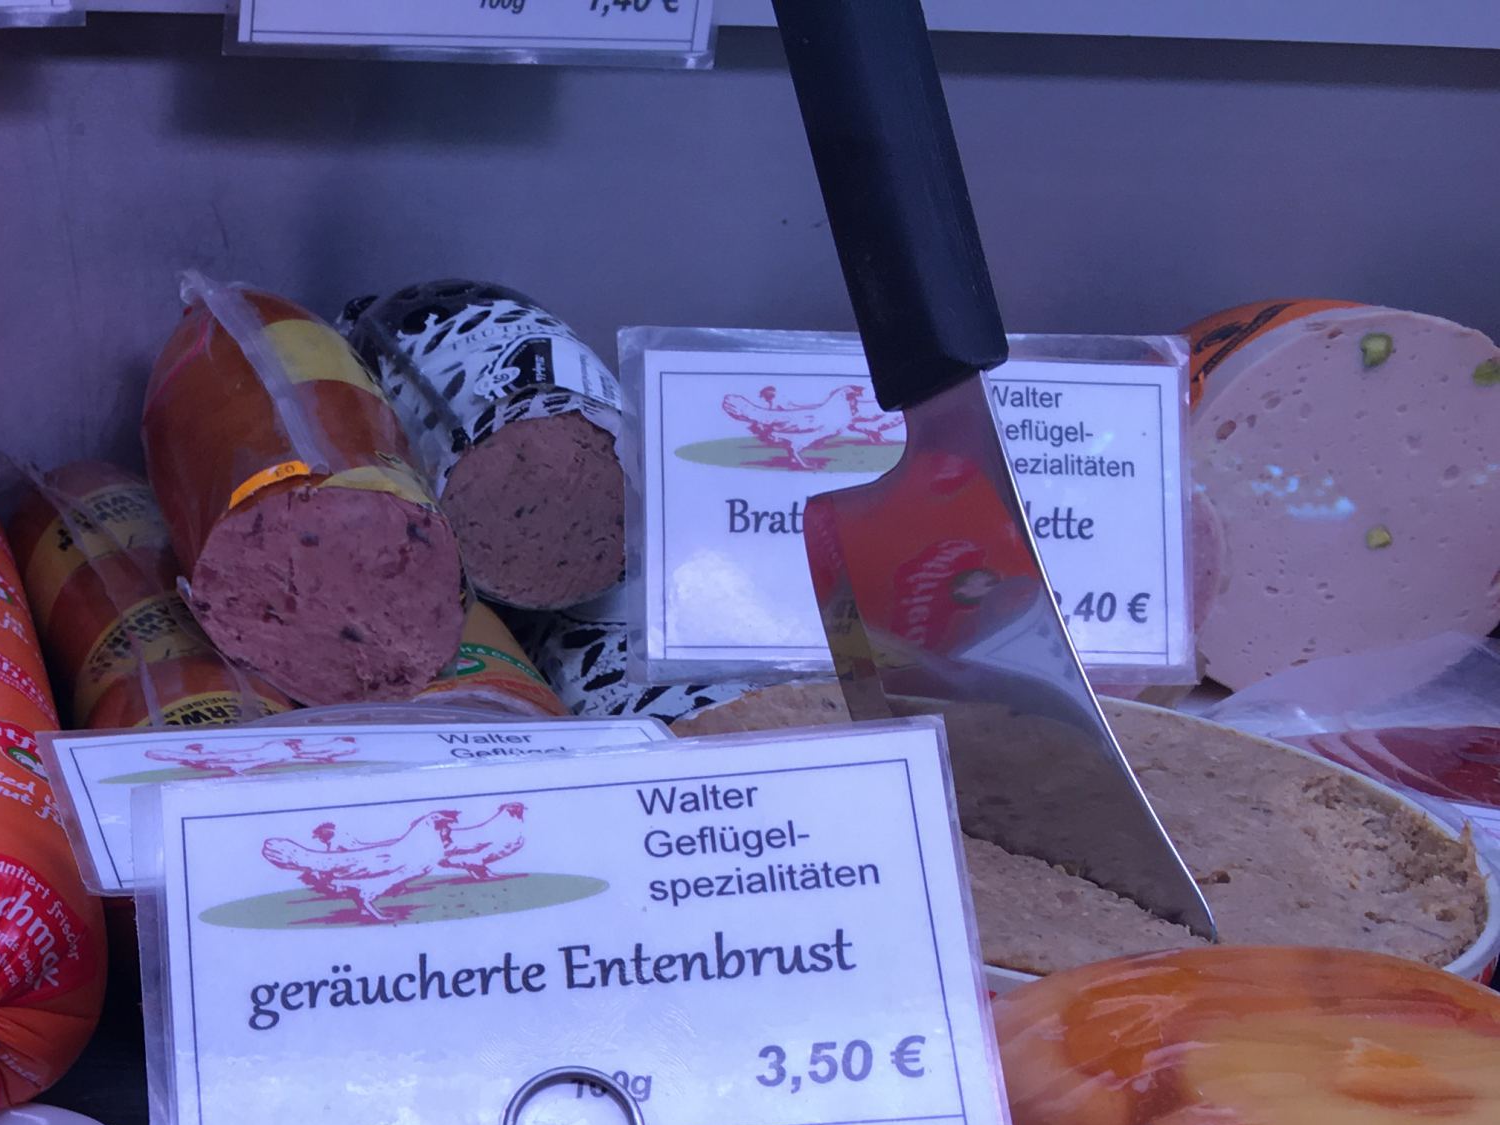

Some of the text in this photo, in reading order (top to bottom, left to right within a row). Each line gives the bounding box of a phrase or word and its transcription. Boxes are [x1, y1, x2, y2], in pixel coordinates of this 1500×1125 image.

[1000, 418, 1094, 448] eflügel-
[1012, 453, 1136, 478] ezialitäten
[724, 498, 804, 535] Brat
[1126, 592, 1152, 624] €
[437, 732, 533, 745] Walter
[637, 784, 758, 816] Walter
[643, 819, 810, 858] Geflügel-
[649, 861, 880, 907] spezialitäten
[248, 928, 858, 1031] geräucherte Entenbrust
[755, 1038, 874, 1095] 3,50
[889, 1034, 927, 1079] €
